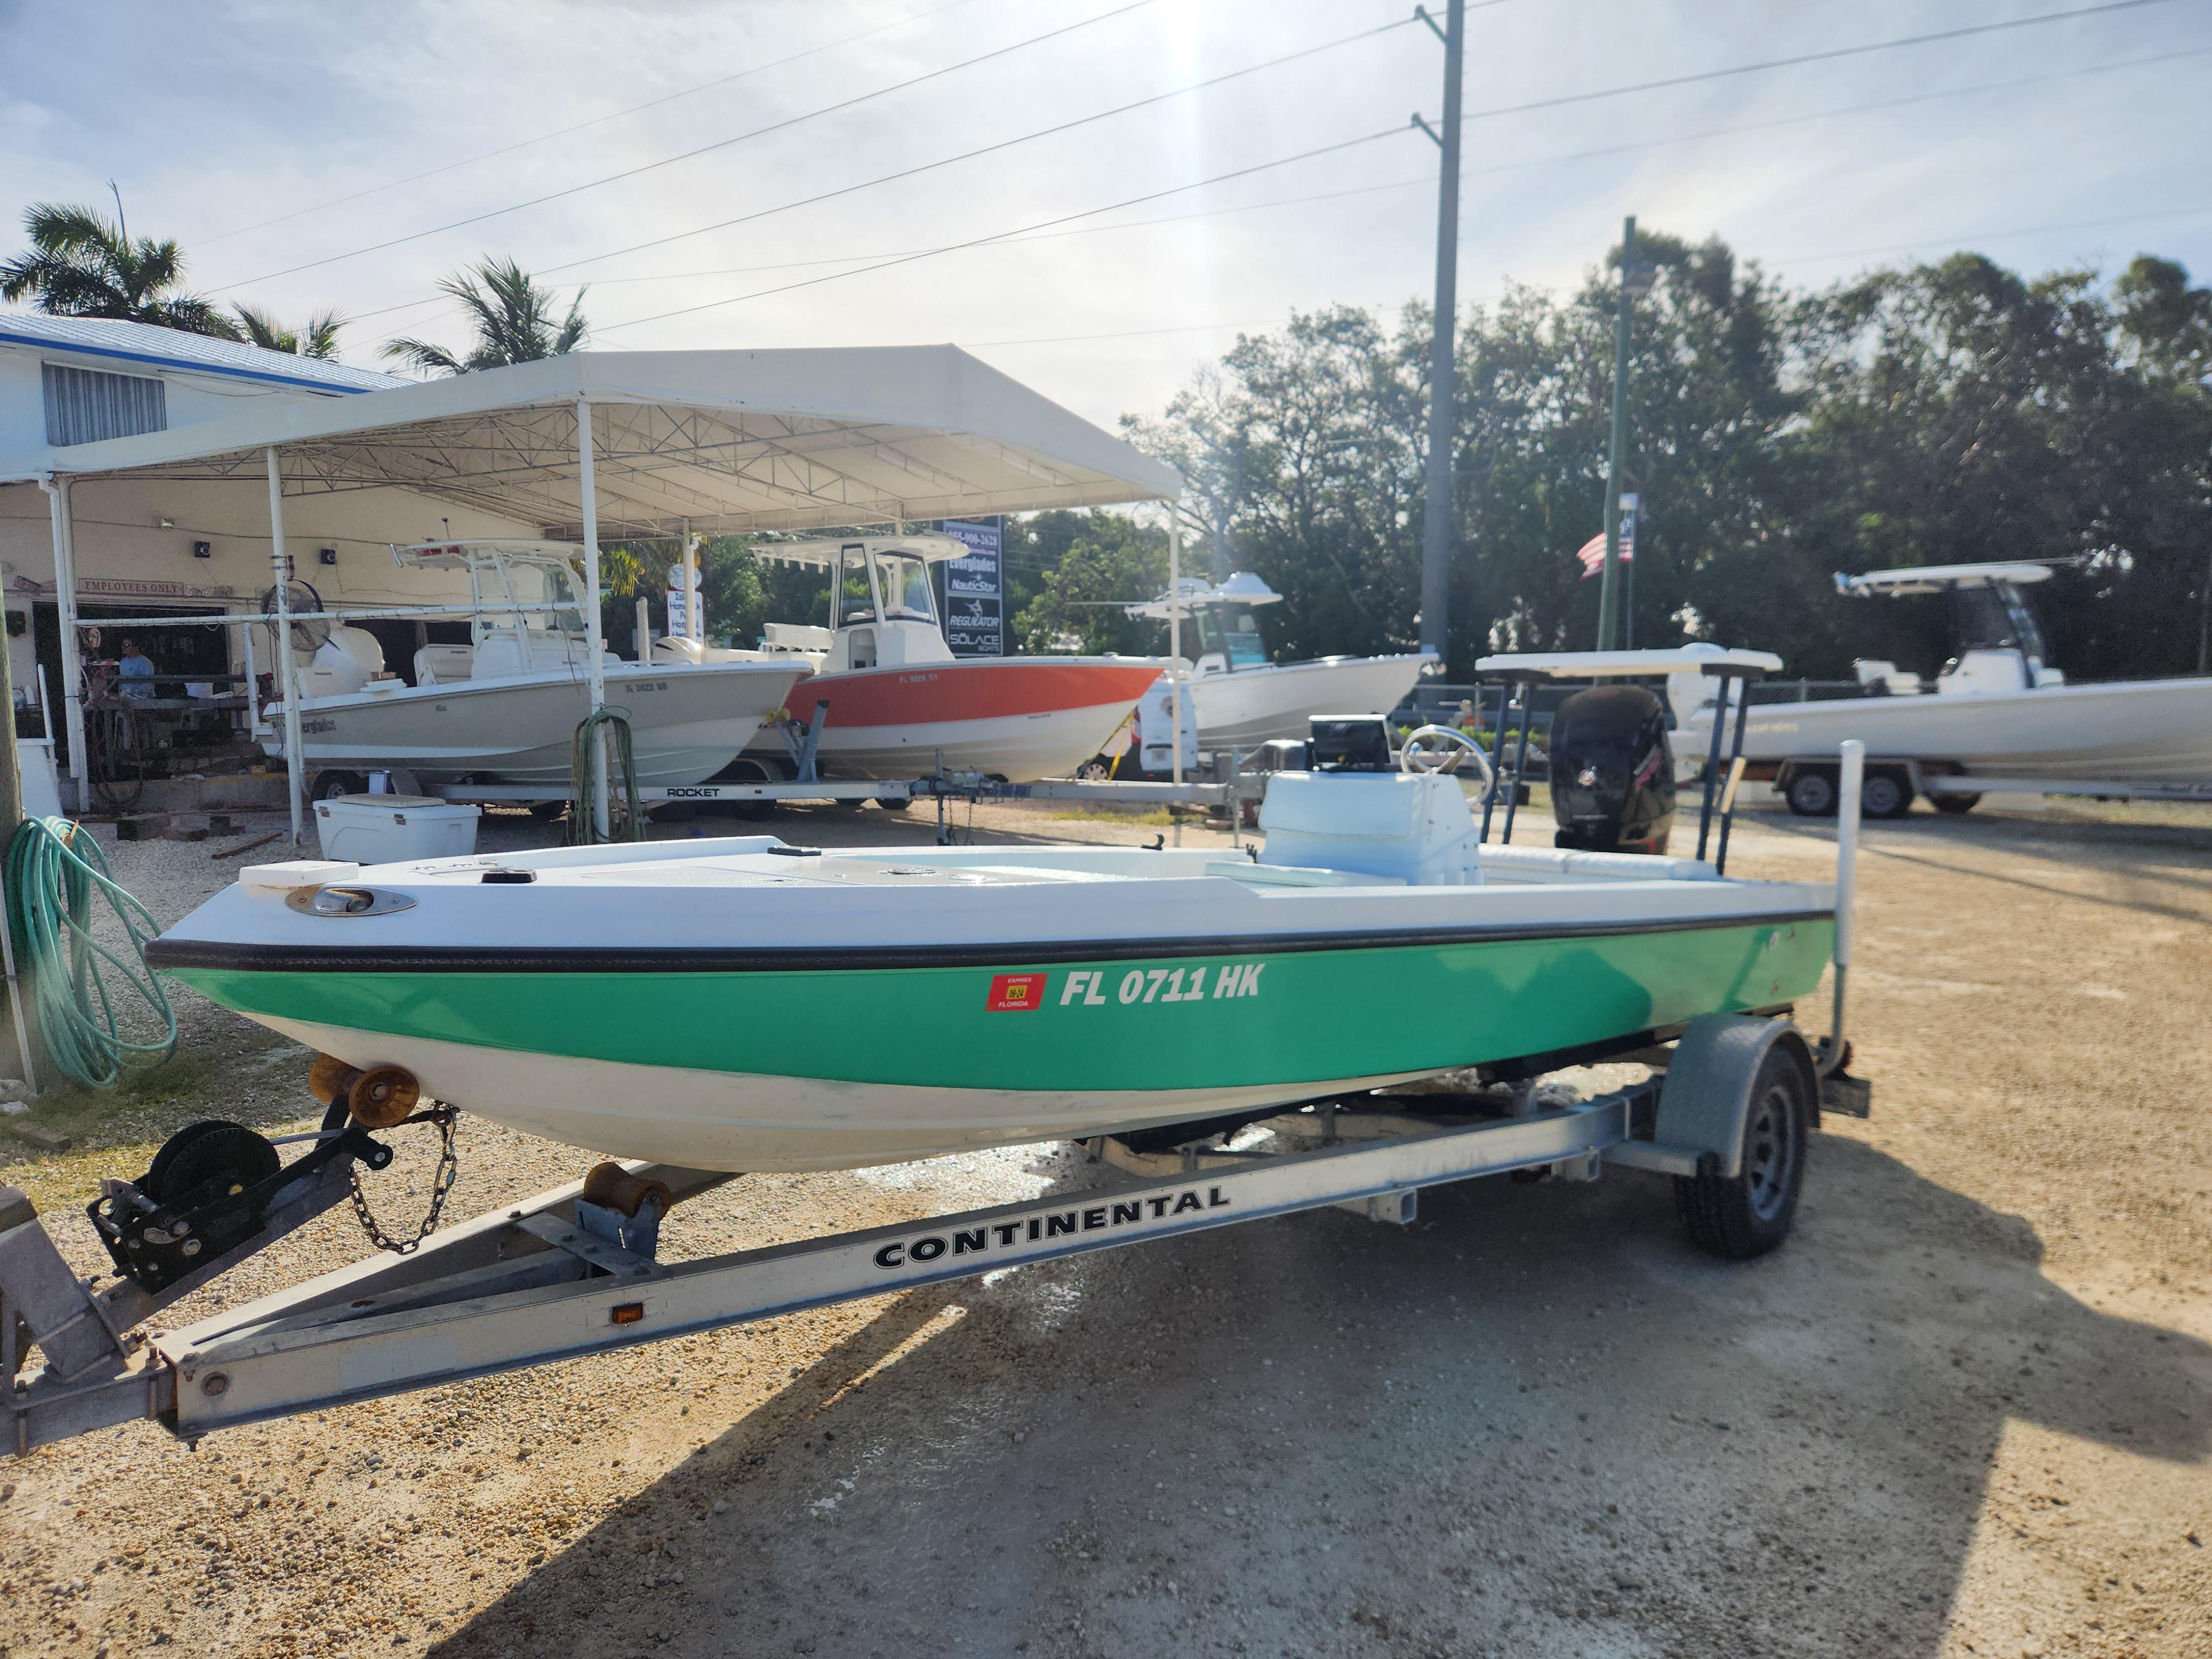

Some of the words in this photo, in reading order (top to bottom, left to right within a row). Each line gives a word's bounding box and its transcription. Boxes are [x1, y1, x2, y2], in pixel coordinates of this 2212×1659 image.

[950, 556, 996, 572] Everglades
[85, 581, 147, 592] EMPLOYEES
[150, 583, 178, 593] ONLY
[951, 578, 997, 593] NauticStar
[950, 615, 999, 627] REGULATOR
[667, 788, 720, 797] ROCKET
[1059, 971, 1106, 1005] FL
[1118, 967, 1207, 1004] 0711
[1213, 963, 1266, 999] HK
[873, 1185, 1230, 1269] CONTINENTAL
